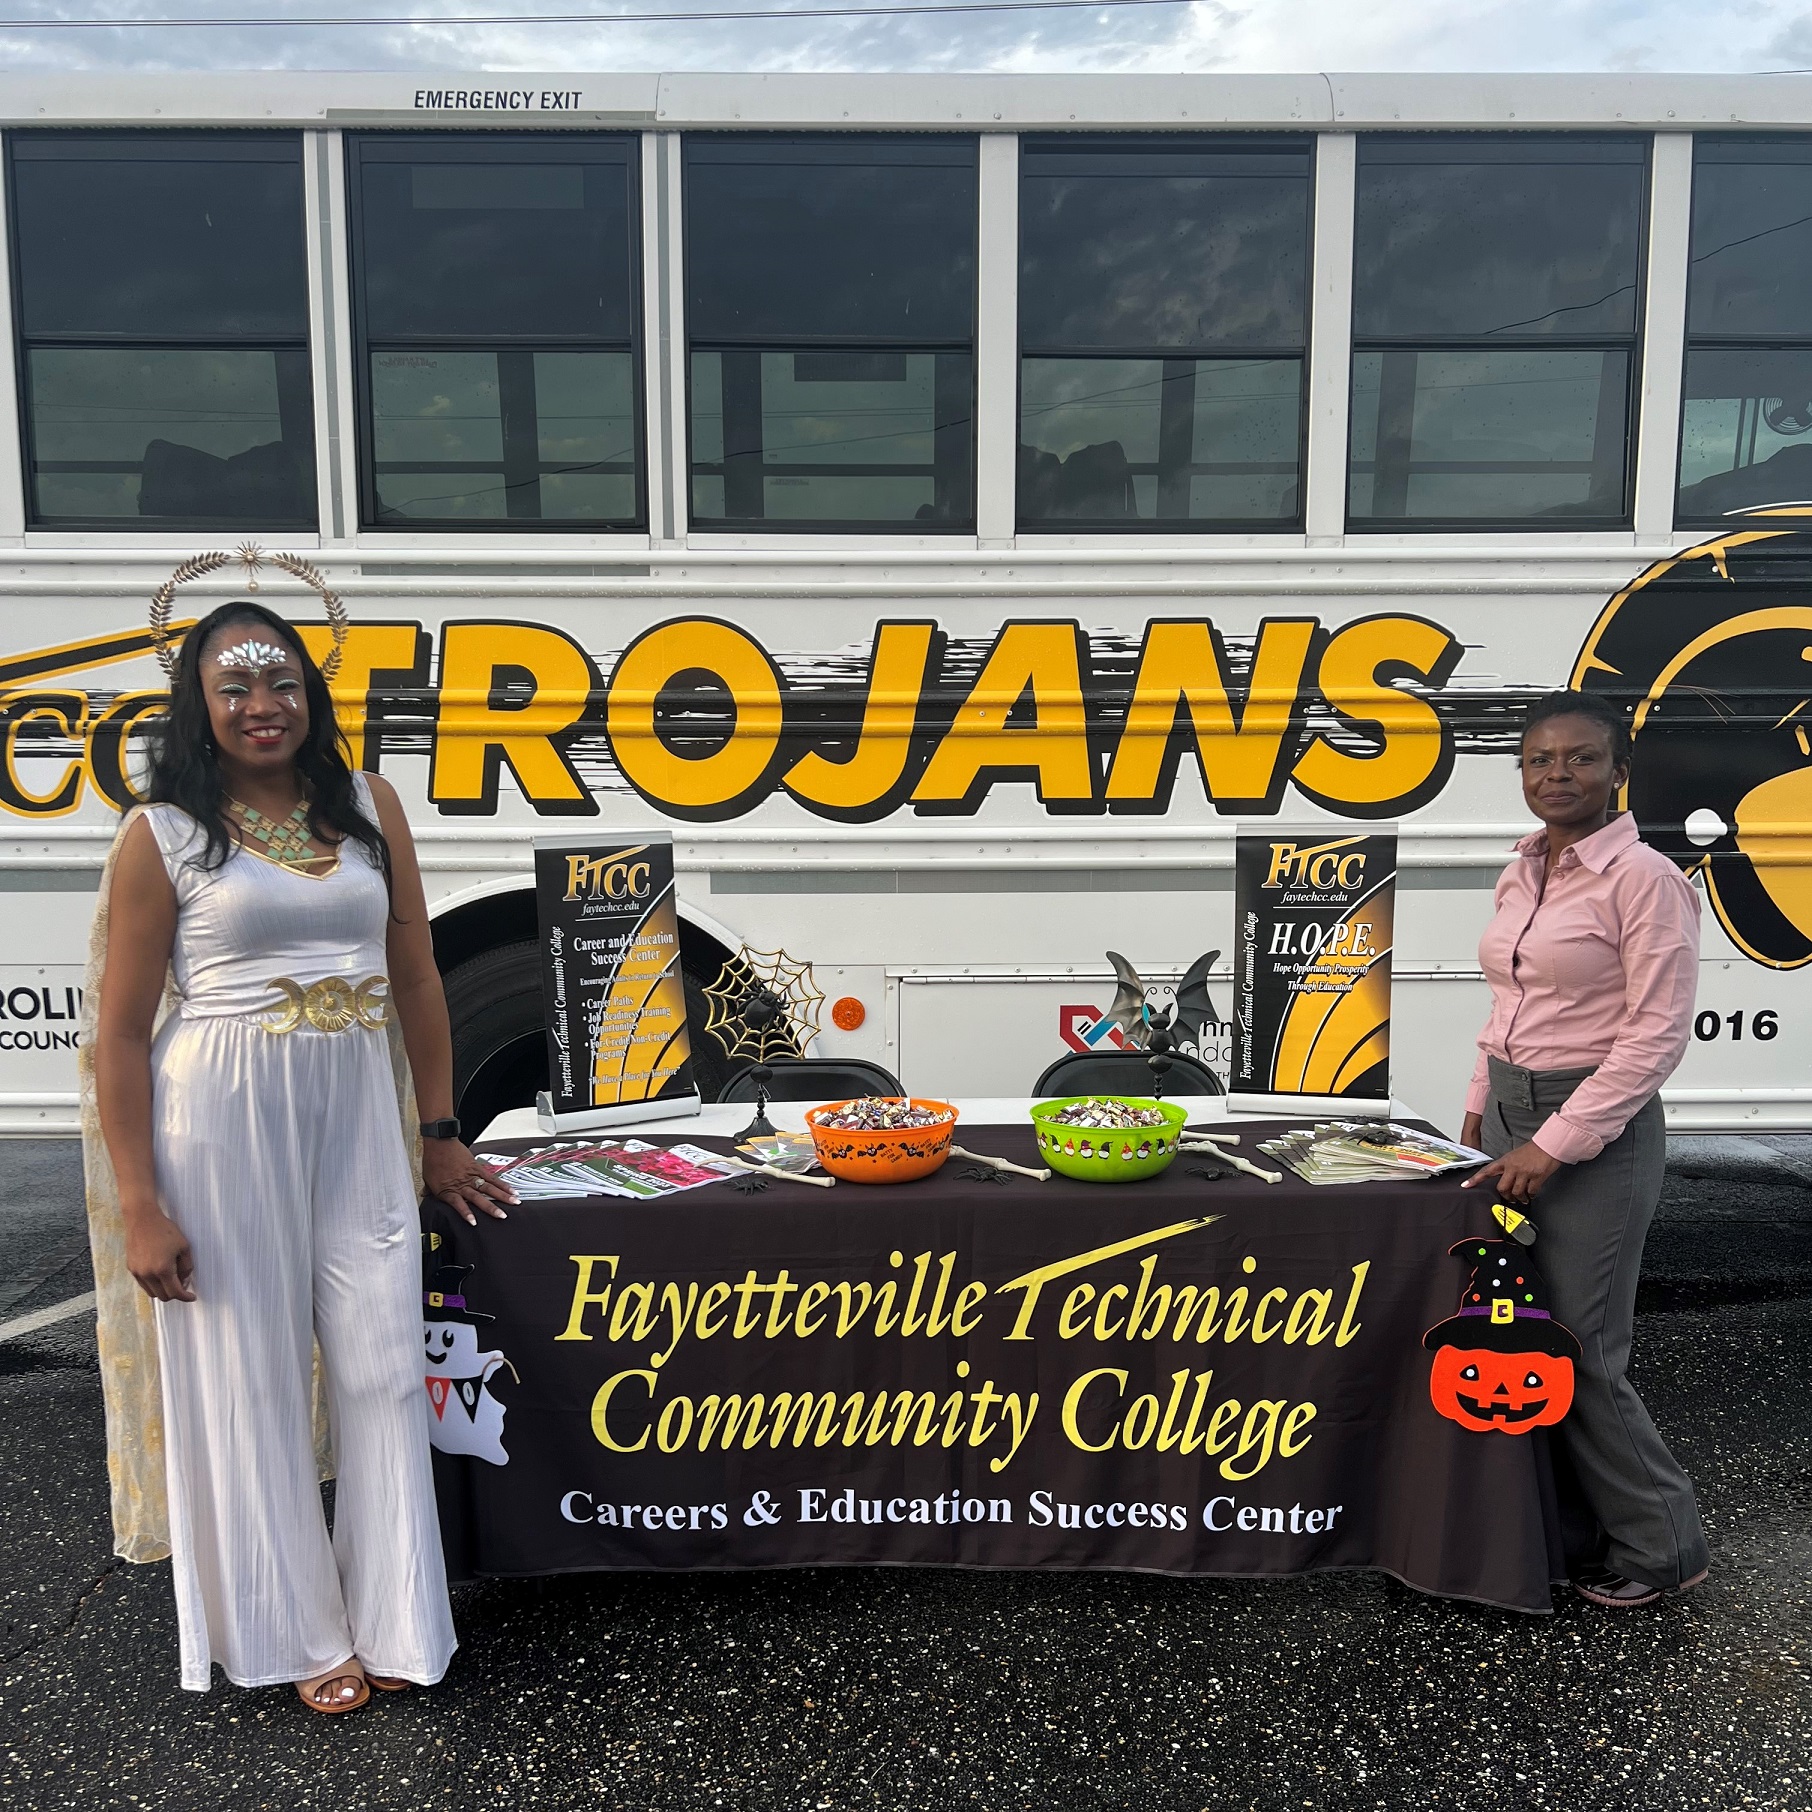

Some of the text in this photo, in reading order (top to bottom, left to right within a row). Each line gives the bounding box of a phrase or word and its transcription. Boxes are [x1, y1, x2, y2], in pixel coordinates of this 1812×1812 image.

[414, 90, 583, 110] EMERGENCY EXIT
[0, 612, 1464, 823] CC TROJANS
[562, 844, 651, 902] FTCC
[1261, 835, 1371, 890] FTCC
[1280, 891, 1348, 904] faytechcc.edu
[581, 900, 640, 917] faytechcc.edu
[574, 930, 674, 951] Career and Education
[1267, 922, 1376, 955] H.O.P.E.
[591, 948, 660, 965] Success Center
[1273, 962, 1370, 977] Hope Opportunity Prosperity
[580, 975, 612, 986] Encouraging
[1287, 980, 1353, 992] Through Education
[0, 987, 84, 1020] OLI
[587, 996, 633, 1010] Career Paths
[1237, 911, 1259, 1080] Fayetteville Technical Community College
[550, 926, 575, 1098] Fayetteville Technical Community College
[588, 1006, 671, 1023] Job Readiness Training
[589, 1022, 638, 1036] Opportunities
[1689, 1010, 1779, 1041] 016
[591, 1049, 626, 1060] Programs
[553, 1213, 1372, 1369] Fayetteville Technical
[590, 1360, 1318, 1481] Community College
[559, 1488, 1343, 1534] Careers & Education Success Center
